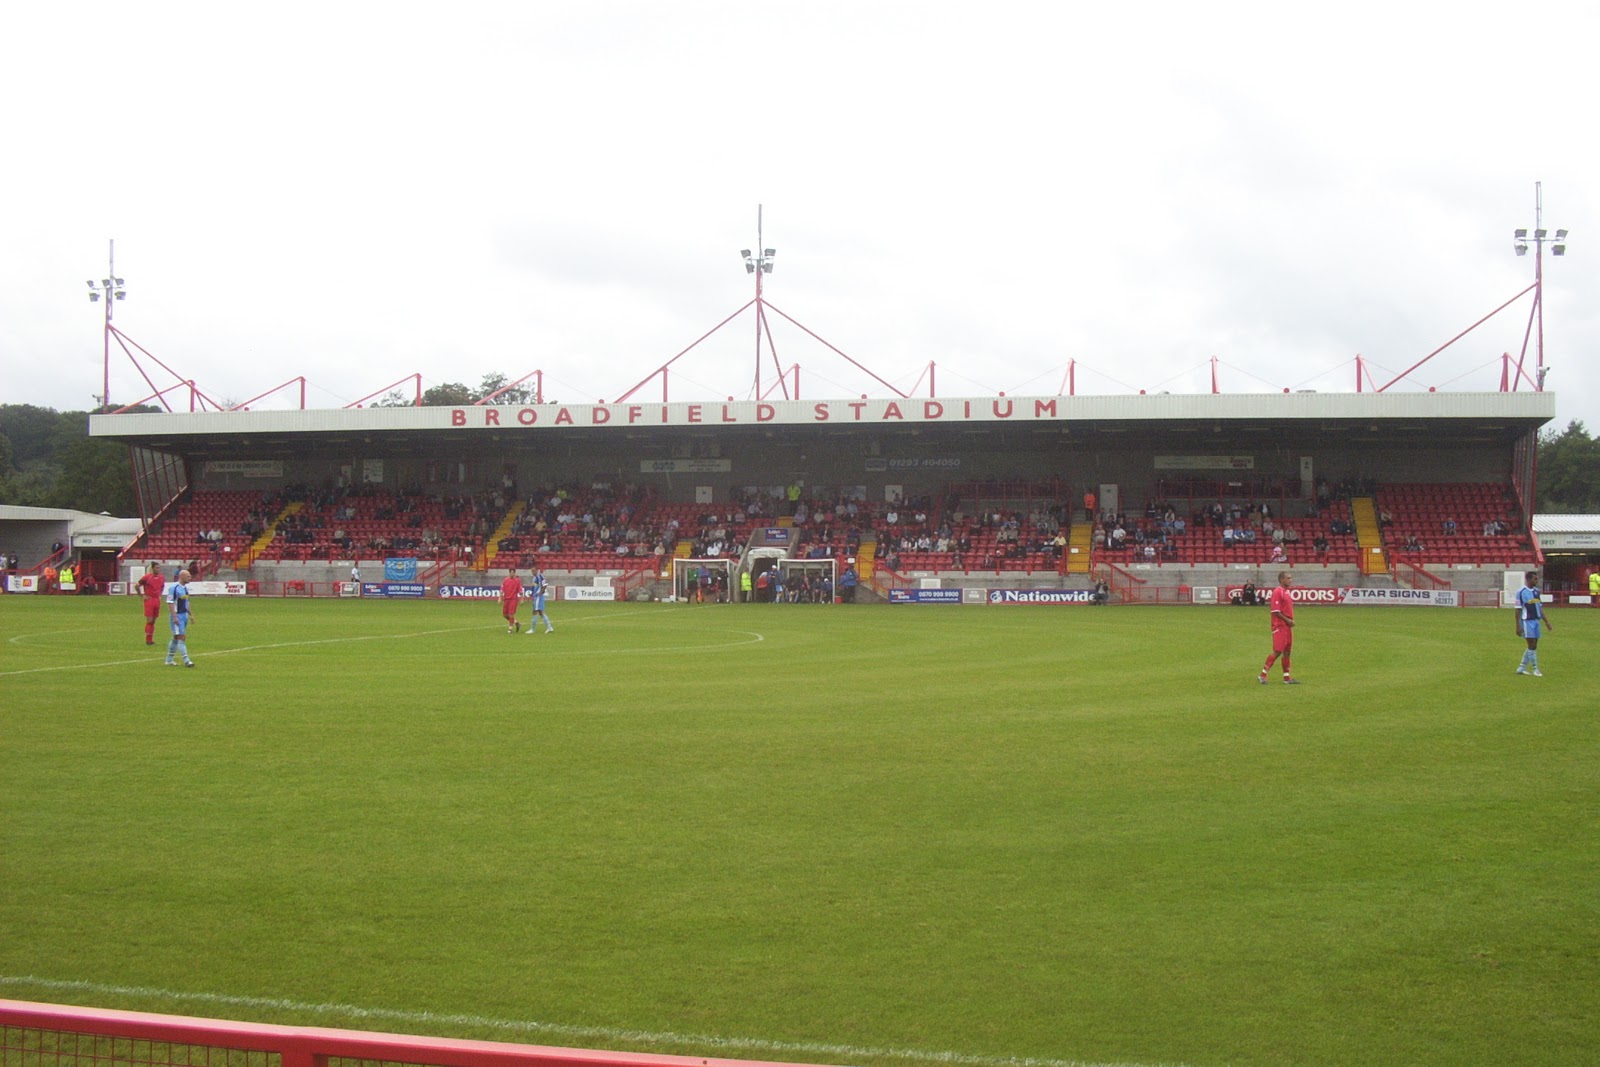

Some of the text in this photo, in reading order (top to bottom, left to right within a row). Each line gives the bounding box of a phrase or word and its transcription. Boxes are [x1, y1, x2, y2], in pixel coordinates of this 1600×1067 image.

[452, 400, 1057, 426] BROADFIELD STADIUM
[453, 586, 533, 598] Nationde
[1005, 591, 1095, 602] Nationwide
[1290, 589, 1335, 600] OTORS
[1351, 589, 1431, 599] STAR SIGNS
